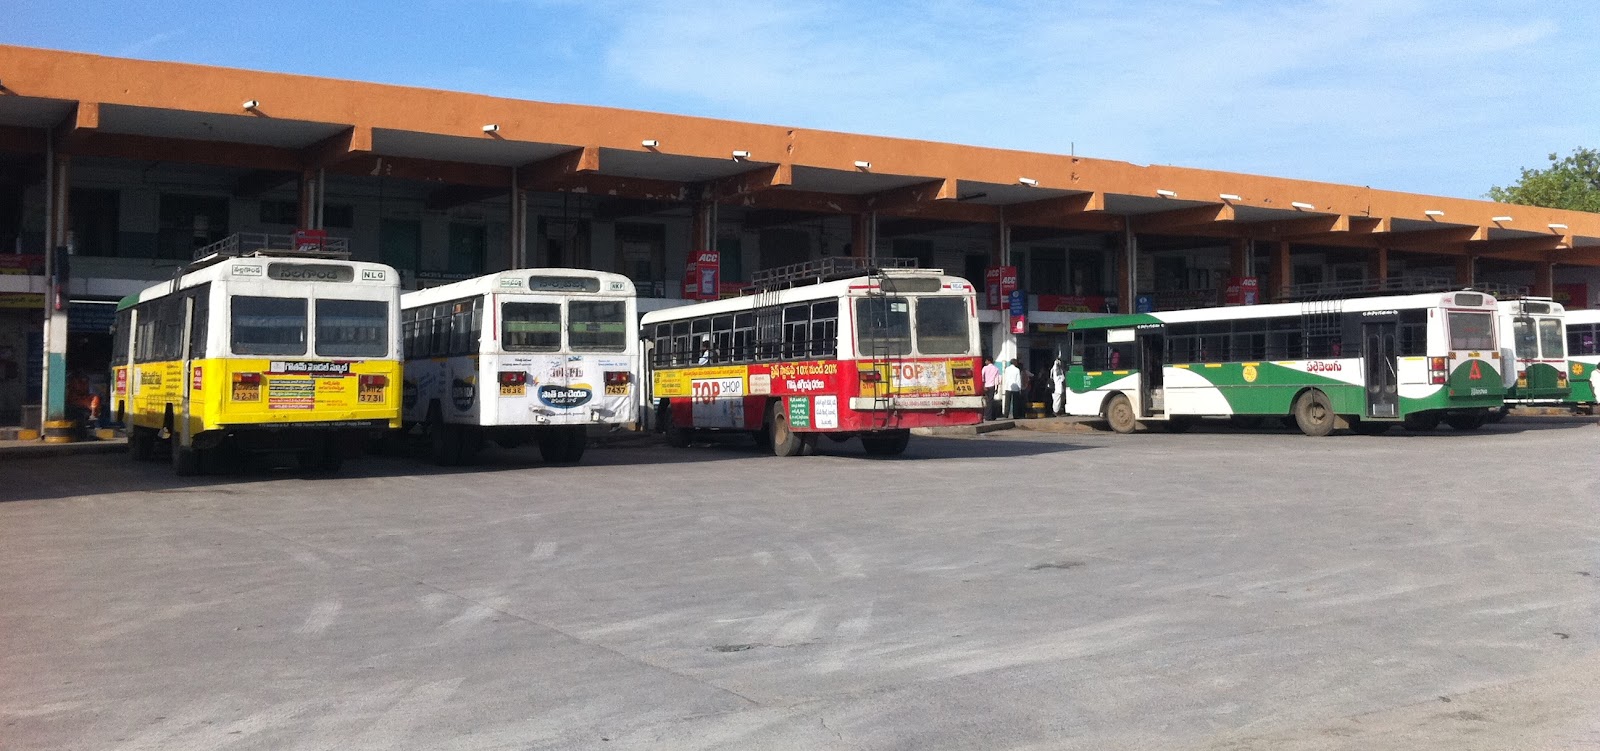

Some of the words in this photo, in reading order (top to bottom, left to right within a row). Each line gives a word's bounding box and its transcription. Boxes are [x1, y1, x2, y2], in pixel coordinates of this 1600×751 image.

[698, 253, 718, 262] ACC
[987, 268, 1000, 278] ACC
[1001, 276, 1016, 285] ACC
[796, 365, 809, 375] 10%
[824, 364, 838, 374] 20%
[892, 364, 924, 380] TOP
[607, 386, 626, 394] 7437
[692, 381, 720, 405] TOP
[721, 380, 740, 393] SHOP
[360, 394, 381, 402] 3731
